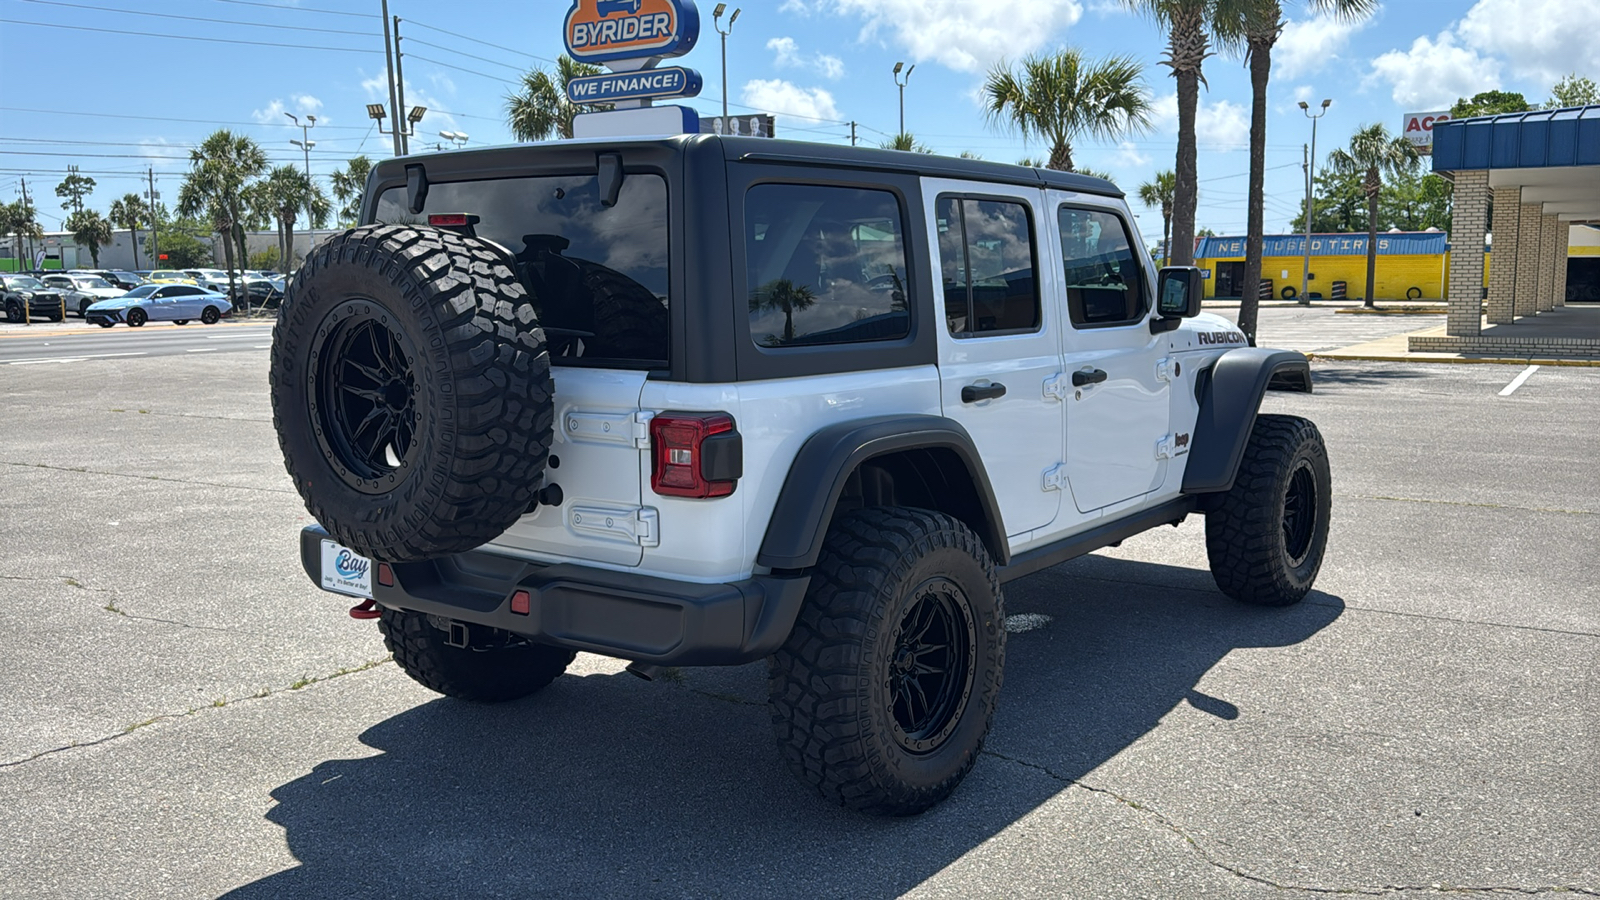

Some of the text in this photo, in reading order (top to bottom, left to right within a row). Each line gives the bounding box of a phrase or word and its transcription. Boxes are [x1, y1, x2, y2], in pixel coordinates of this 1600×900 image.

[573, 13, 670, 46] BYRIDER
[572, 73, 679, 97] WE FINANCE!
[1274, 240, 1322, 251] USED
[281, 286, 321, 389] FORTUNE
[1197, 331, 1247, 346] RUBICON
[338, 549, 369, 579] Bay
[978, 608, 998, 714] FORTUNE
